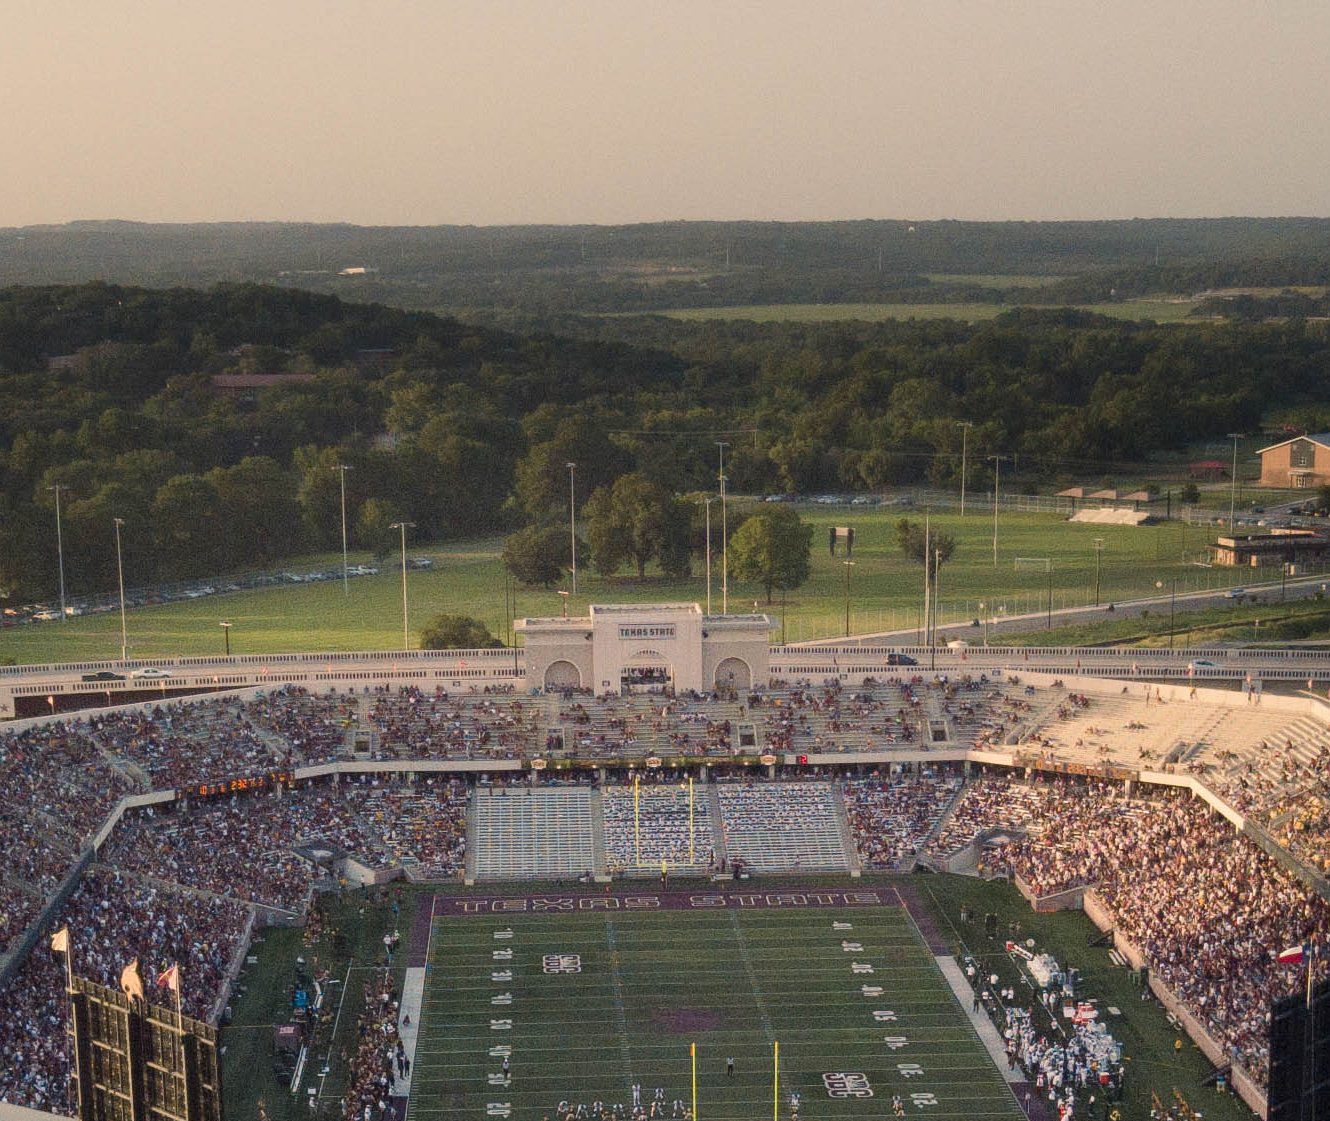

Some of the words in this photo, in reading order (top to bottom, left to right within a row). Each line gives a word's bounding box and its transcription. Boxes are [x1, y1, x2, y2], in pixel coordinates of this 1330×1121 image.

[620, 628, 648, 637] TEXAS
[649, 627, 675, 636] STATE
[455, 896, 661, 912] TEXAS
[689, 892, 881, 907] STATE
